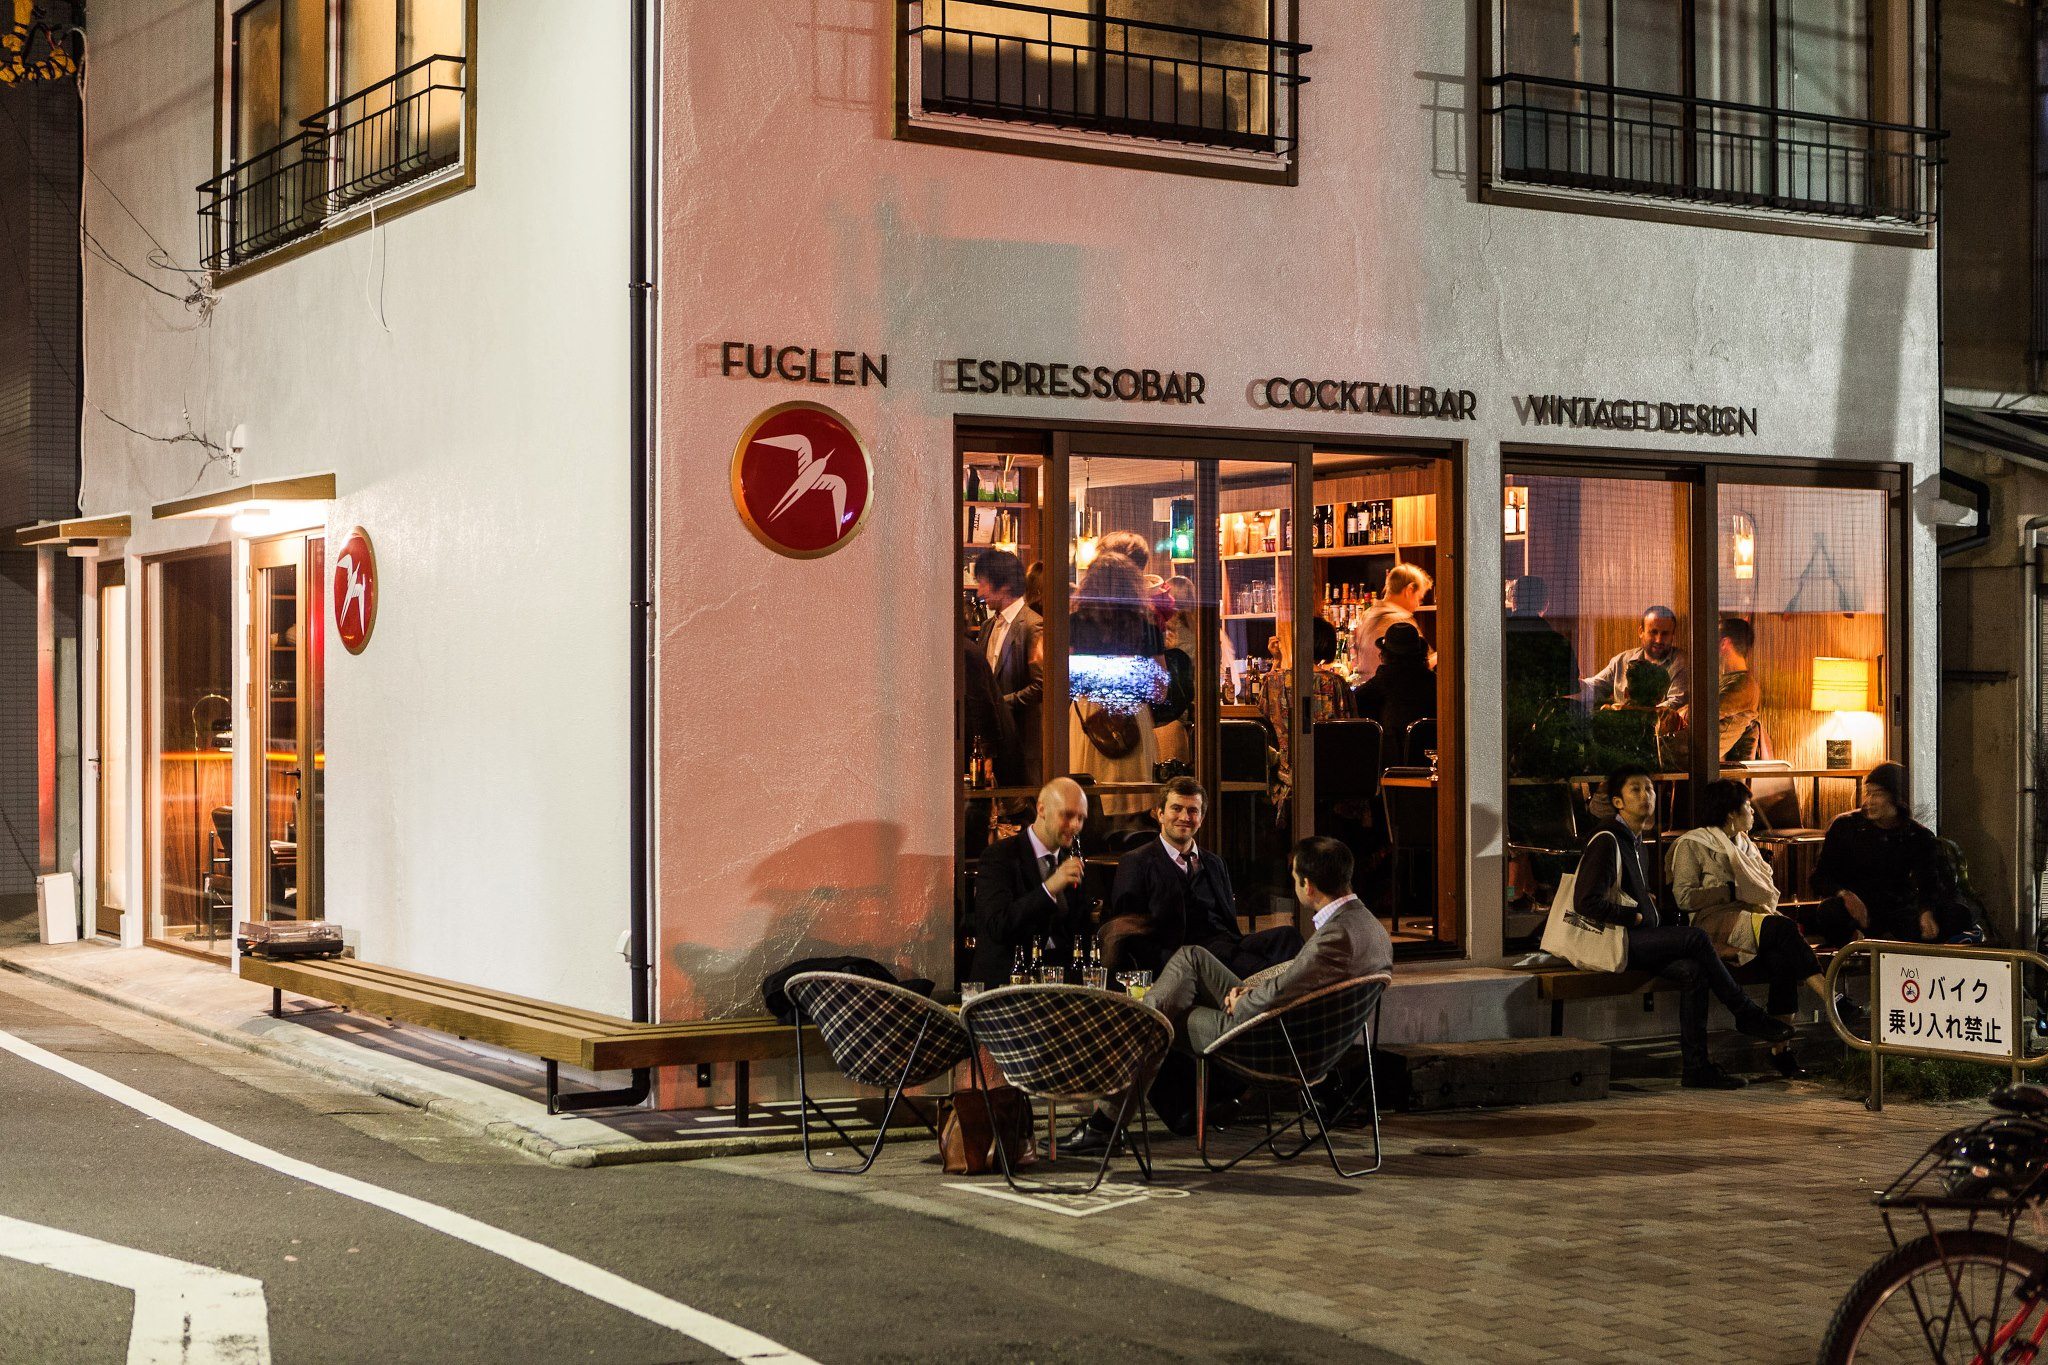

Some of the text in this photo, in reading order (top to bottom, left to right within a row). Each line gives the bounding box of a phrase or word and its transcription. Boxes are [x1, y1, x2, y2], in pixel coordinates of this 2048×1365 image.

[722, 341, 1758, 437] FUGLEN ESPRESSOBAR COCKTAILBAR VINTAGE DESIGN
[1928, 976, 1988, 1004] バイク
[1889, 1009, 2002, 1043] 乗り入れ禁止
